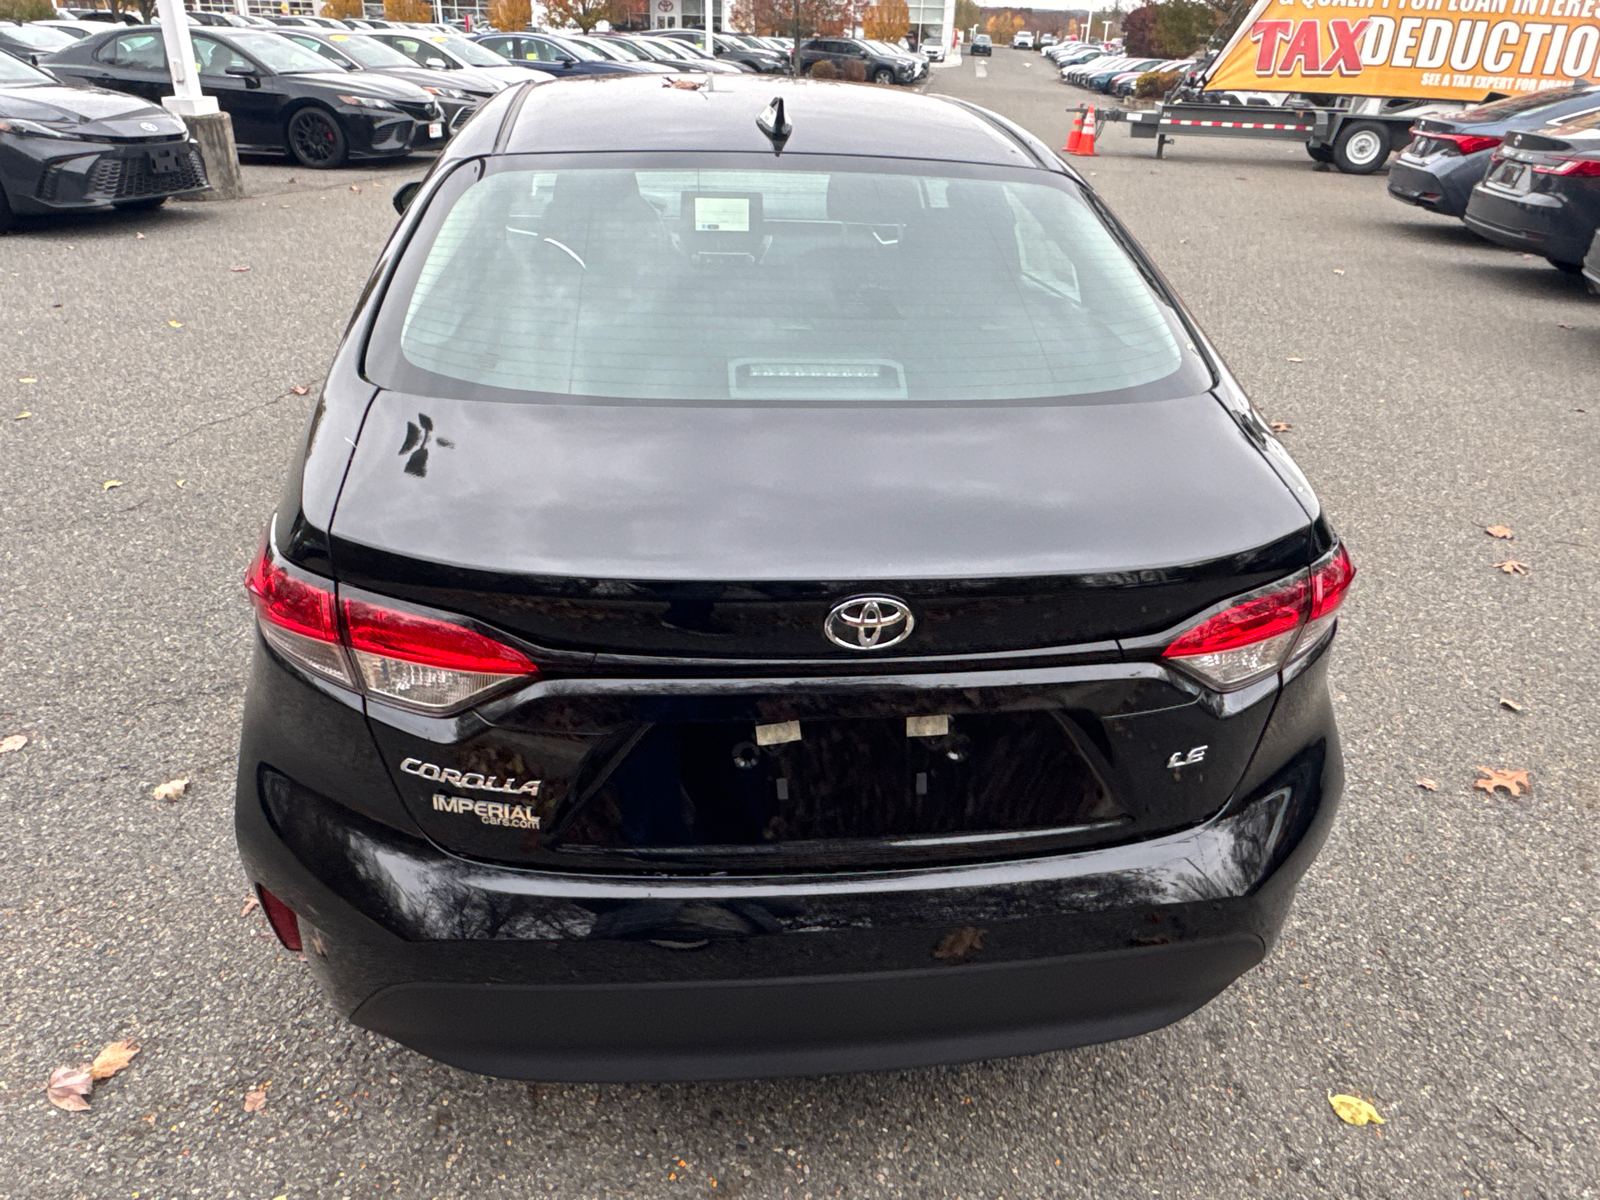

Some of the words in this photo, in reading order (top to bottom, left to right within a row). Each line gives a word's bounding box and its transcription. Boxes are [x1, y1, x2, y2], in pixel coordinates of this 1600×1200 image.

[1250, 19, 1373, 77] TAX
[1361, 15, 1600, 78] DEDUCTIO
[1421, 72, 1441, 86] SEE
[1441, 74, 1451, 87] A
[1452, 74, 1474, 88] TAX
[1473, 75, 1514, 91] EXPERT
[1513, 77, 1538, 92] FOR
[1166, 744, 1209, 769] LE
[400, 757, 542, 797] COROLLA
[432, 793, 541, 822] IMPERIAL
[481, 815, 541, 830] cars.com
